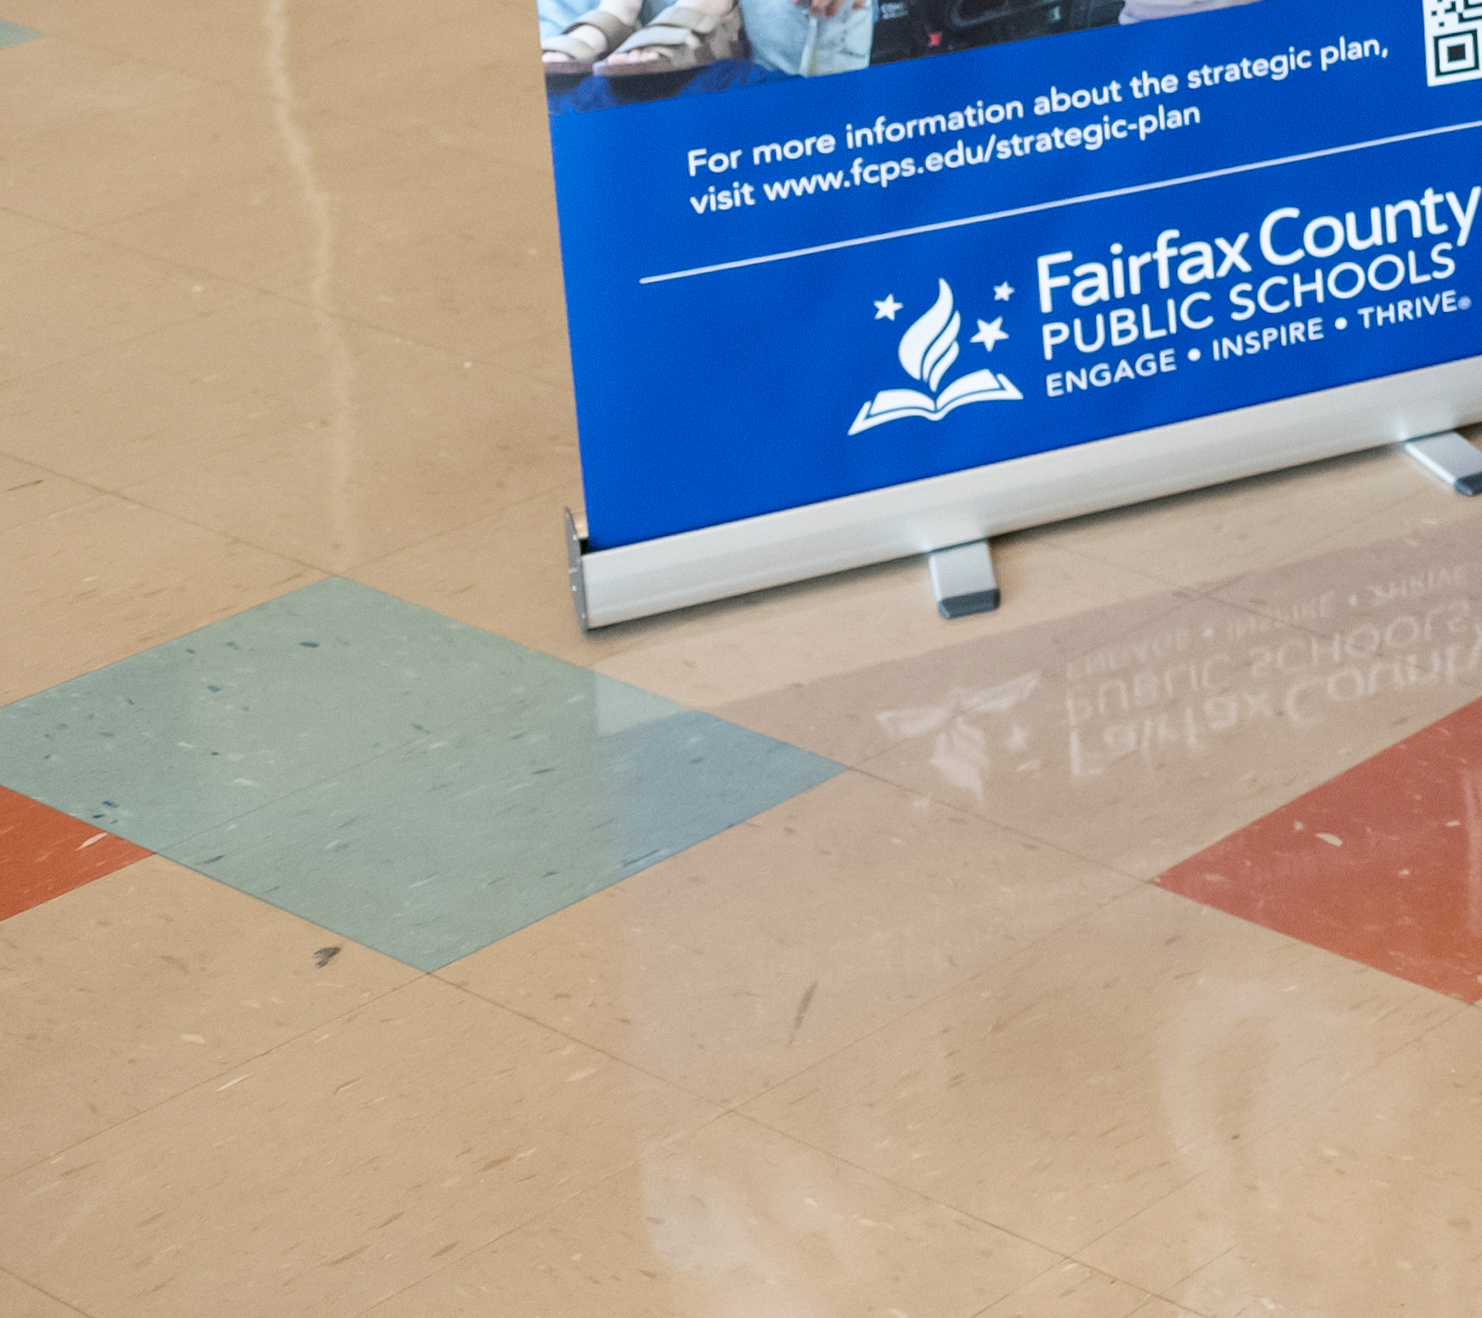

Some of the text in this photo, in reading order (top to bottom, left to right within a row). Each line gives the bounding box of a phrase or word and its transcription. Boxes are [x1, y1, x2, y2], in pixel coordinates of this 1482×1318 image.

[688, 36, 1388, 177] For more information about the strategic plan,
[690, 105, 1201, 214] visit www.fcps.edu/strategic-plan
[1037, 186, 1482, 313] Fairfax County
[1042, 242, 1456, 361] PUBLIC SCHOOLS
[1045, 349, 1177, 397] ENGAGE
[1212, 317, 1325, 361] INSPIRE
